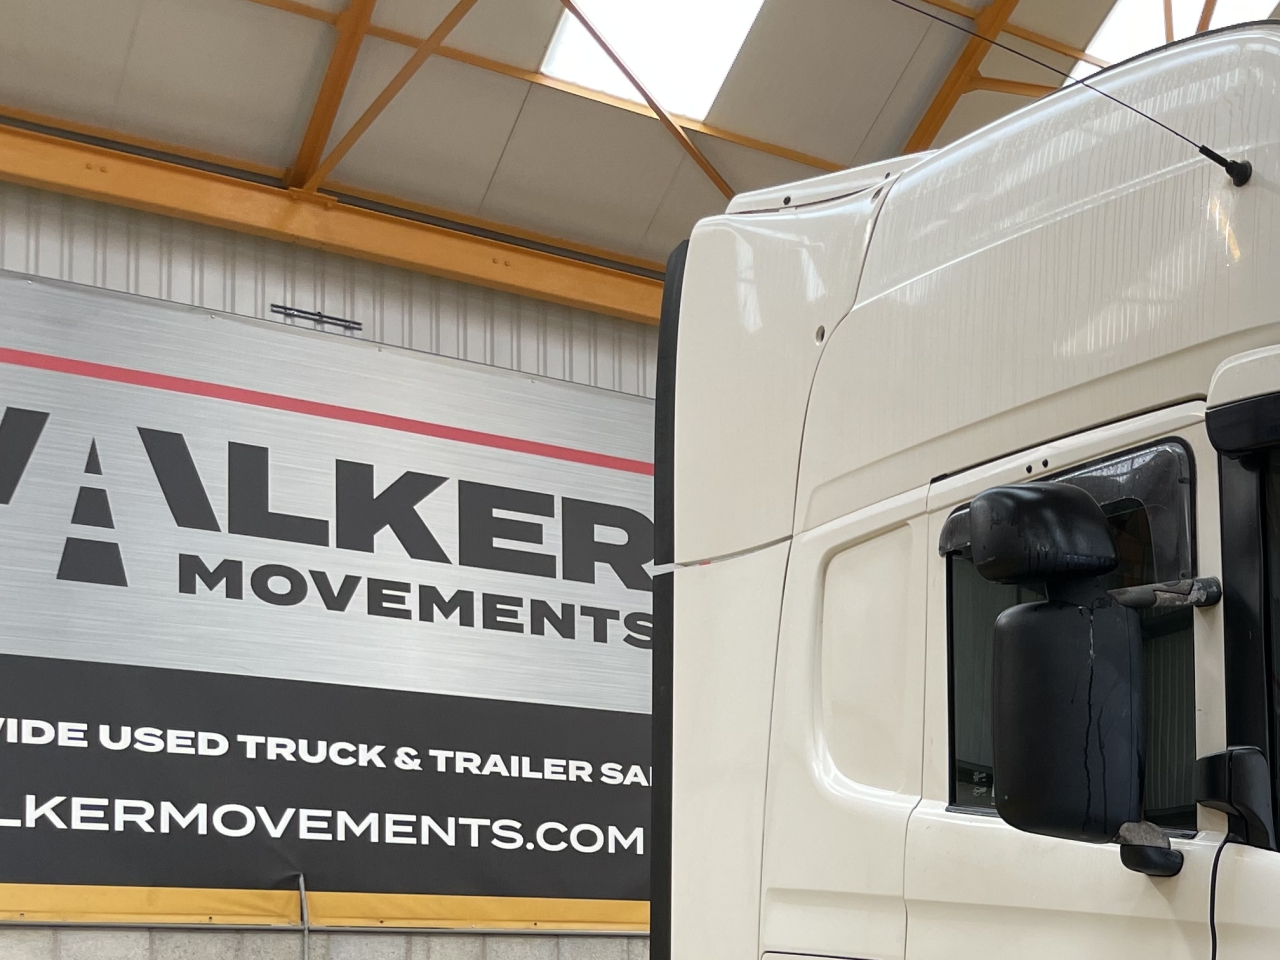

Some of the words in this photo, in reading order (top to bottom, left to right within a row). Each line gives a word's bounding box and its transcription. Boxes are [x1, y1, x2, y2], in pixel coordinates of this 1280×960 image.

[179, 553, 654, 649] MOVEMENTS
[99, 725, 228, 756] USED
[237, 735, 386, 767] TRUCK
[394, 746, 422, 770] &
[429, 749, 593, 782] TRAILER
[600, 764, 653, 787] SA
